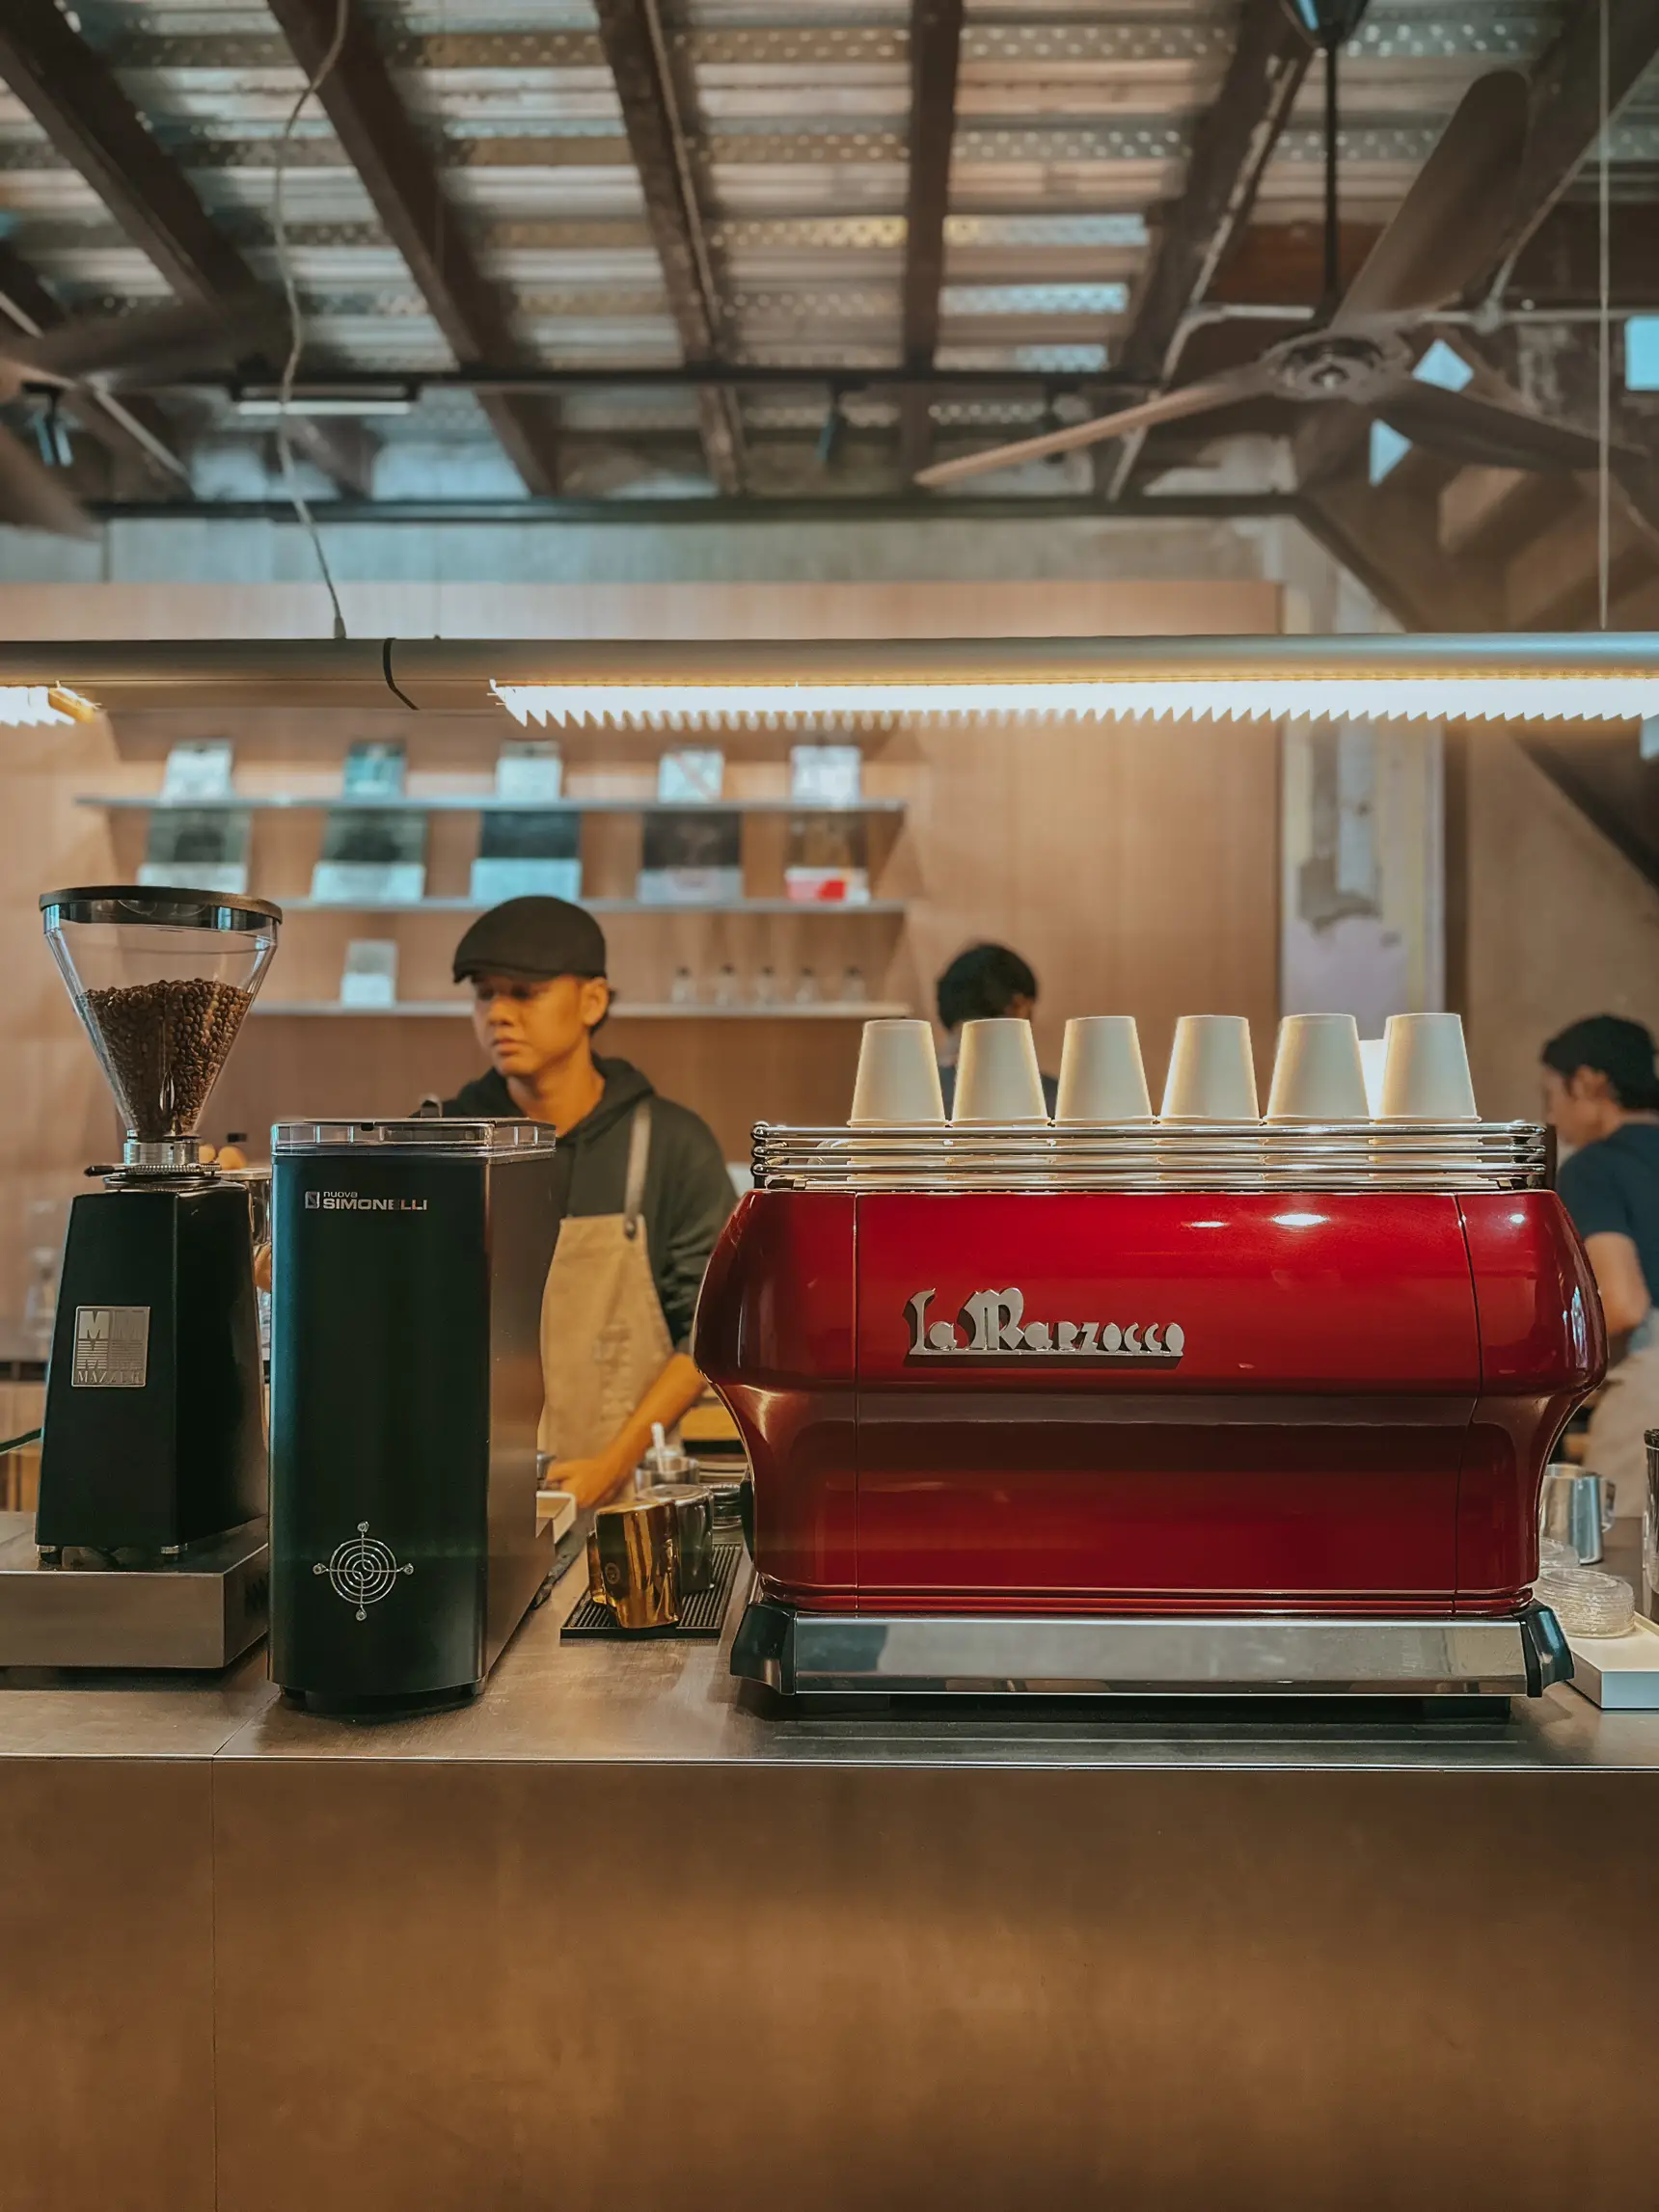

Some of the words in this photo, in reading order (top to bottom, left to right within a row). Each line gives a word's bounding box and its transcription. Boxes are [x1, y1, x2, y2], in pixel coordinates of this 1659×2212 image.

[322, 1199, 427, 1210] SIMONELLI
[910, 1287, 957, 1352] La
[964, 1287, 1185, 1353] Marzocco
